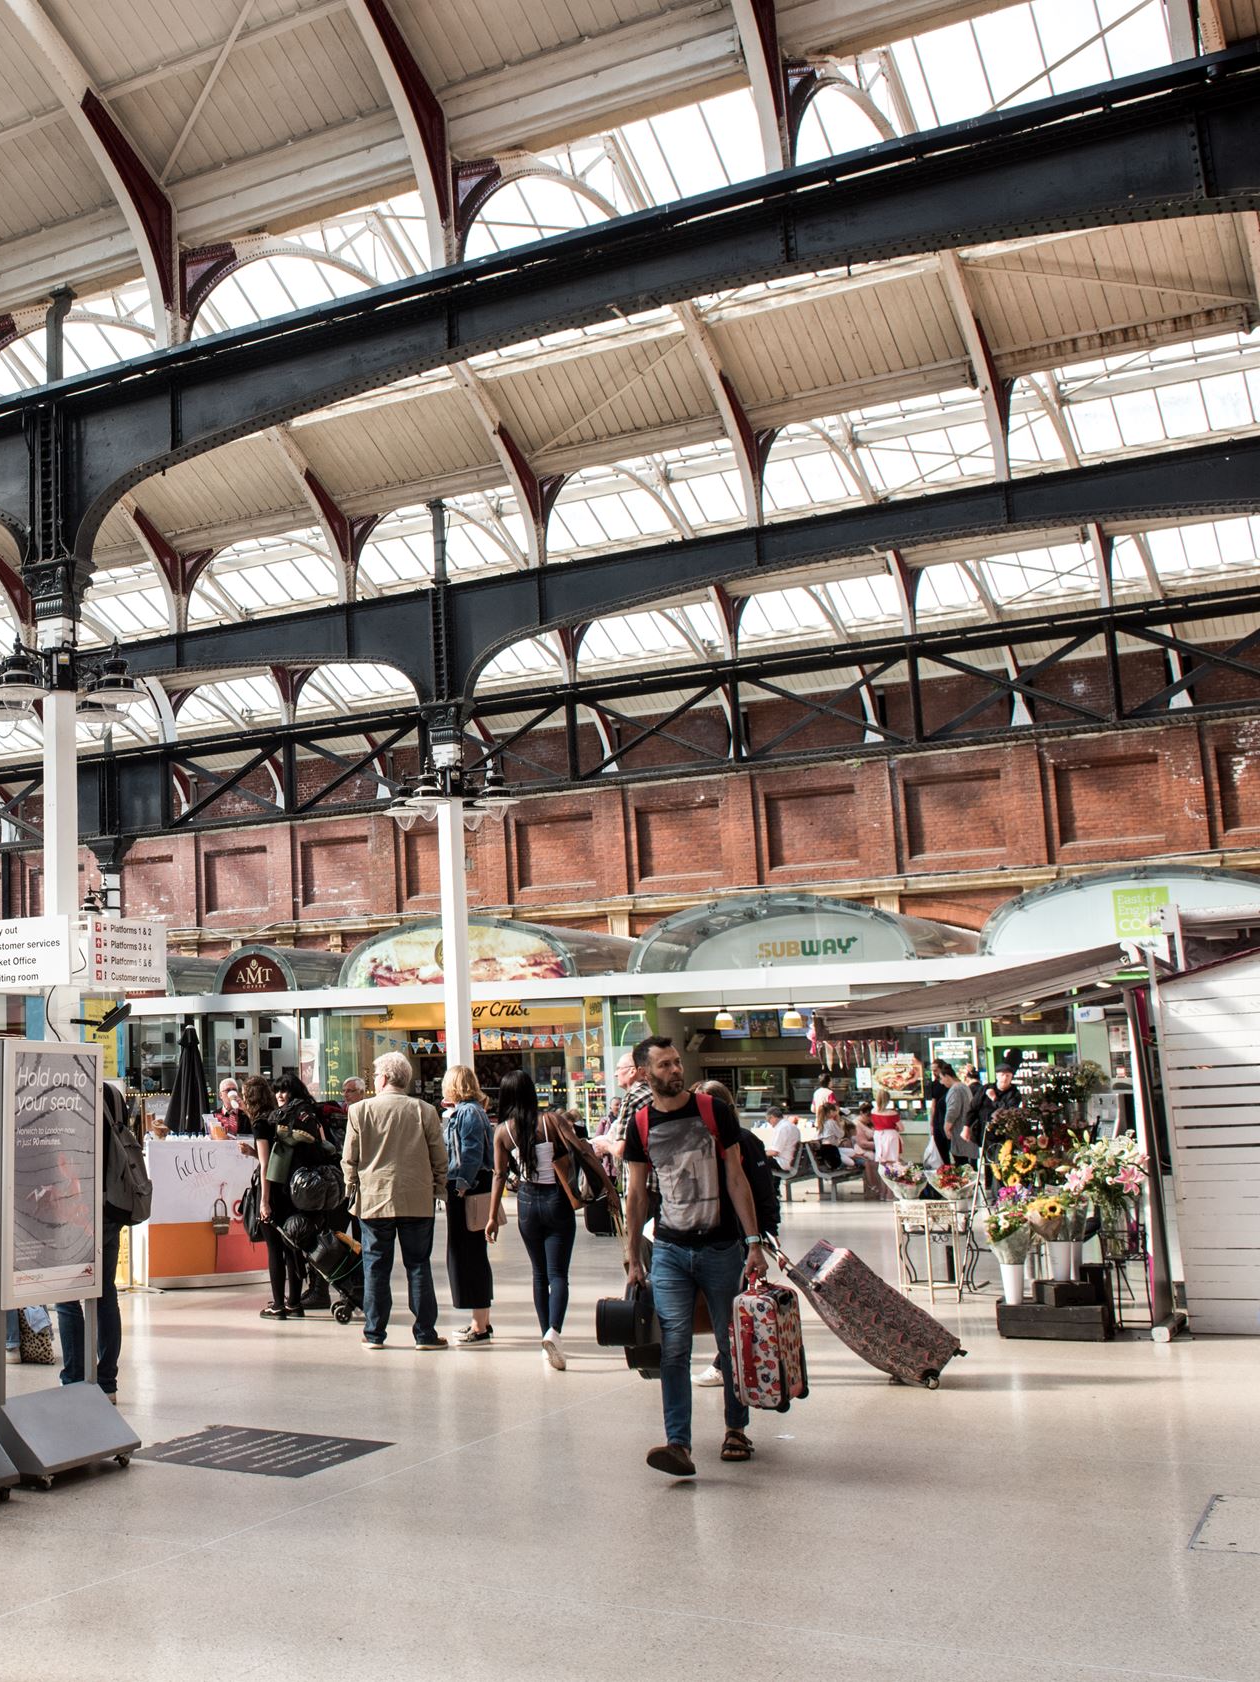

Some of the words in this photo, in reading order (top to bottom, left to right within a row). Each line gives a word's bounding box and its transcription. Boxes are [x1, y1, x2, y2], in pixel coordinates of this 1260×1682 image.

[1117, 894, 1141, 905] East
[1144, 893, 1157, 902] of
[1118, 905, 1158, 920] Englan
[5, 926, 18, 935] out
[111, 925, 137, 934] Platforms
[148, 928, 152, 936] 2
[27, 939, 60, 948] services
[111, 941, 137, 951] Platforms
[143, 943, 147, 951] &
[757, 936, 858, 959] SUBWAY
[13, 957, 37, 966] Office
[111, 957, 137, 966] Platforms
[18, 973, 39, 981] room
[111, 972, 138, 982] Customer
[139, 975, 161, 983] services
[236, 967, 273, 985] AMT
[17, 1066, 51, 1087] Hold
[52, 1073, 70, 1087] on
[73, 1070, 87, 1087] to
[16, 1095, 48, 1116] your
[50, 1094, 83, 1111] seat.
[16, 1127, 38, 1135] Norwich
[22, 1139, 32, 1148] just
[175, 1148, 217, 1181] hello
